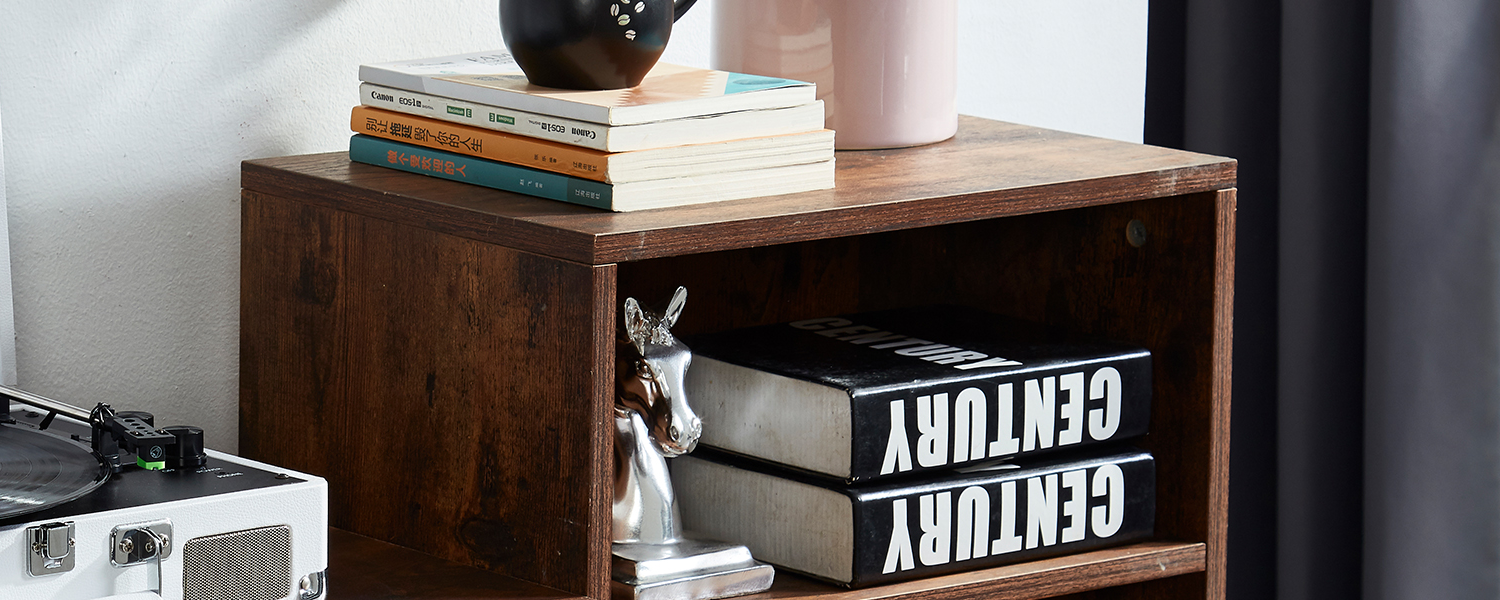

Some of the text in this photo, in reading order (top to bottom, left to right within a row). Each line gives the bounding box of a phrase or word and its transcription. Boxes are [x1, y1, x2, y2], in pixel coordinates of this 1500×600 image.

[371, 91, 394, 103] Canon
[366, 117, 483, 153] 别让拖延毁了你的人生
[572, 127, 596, 139] Canon
[387, 150, 467, 178] 做个受欢迎的人
[789, 317, 1023, 370] CENTURY
[880, 366, 1122, 476] CENTURY
[882, 463, 1125, 575] CENTURY
